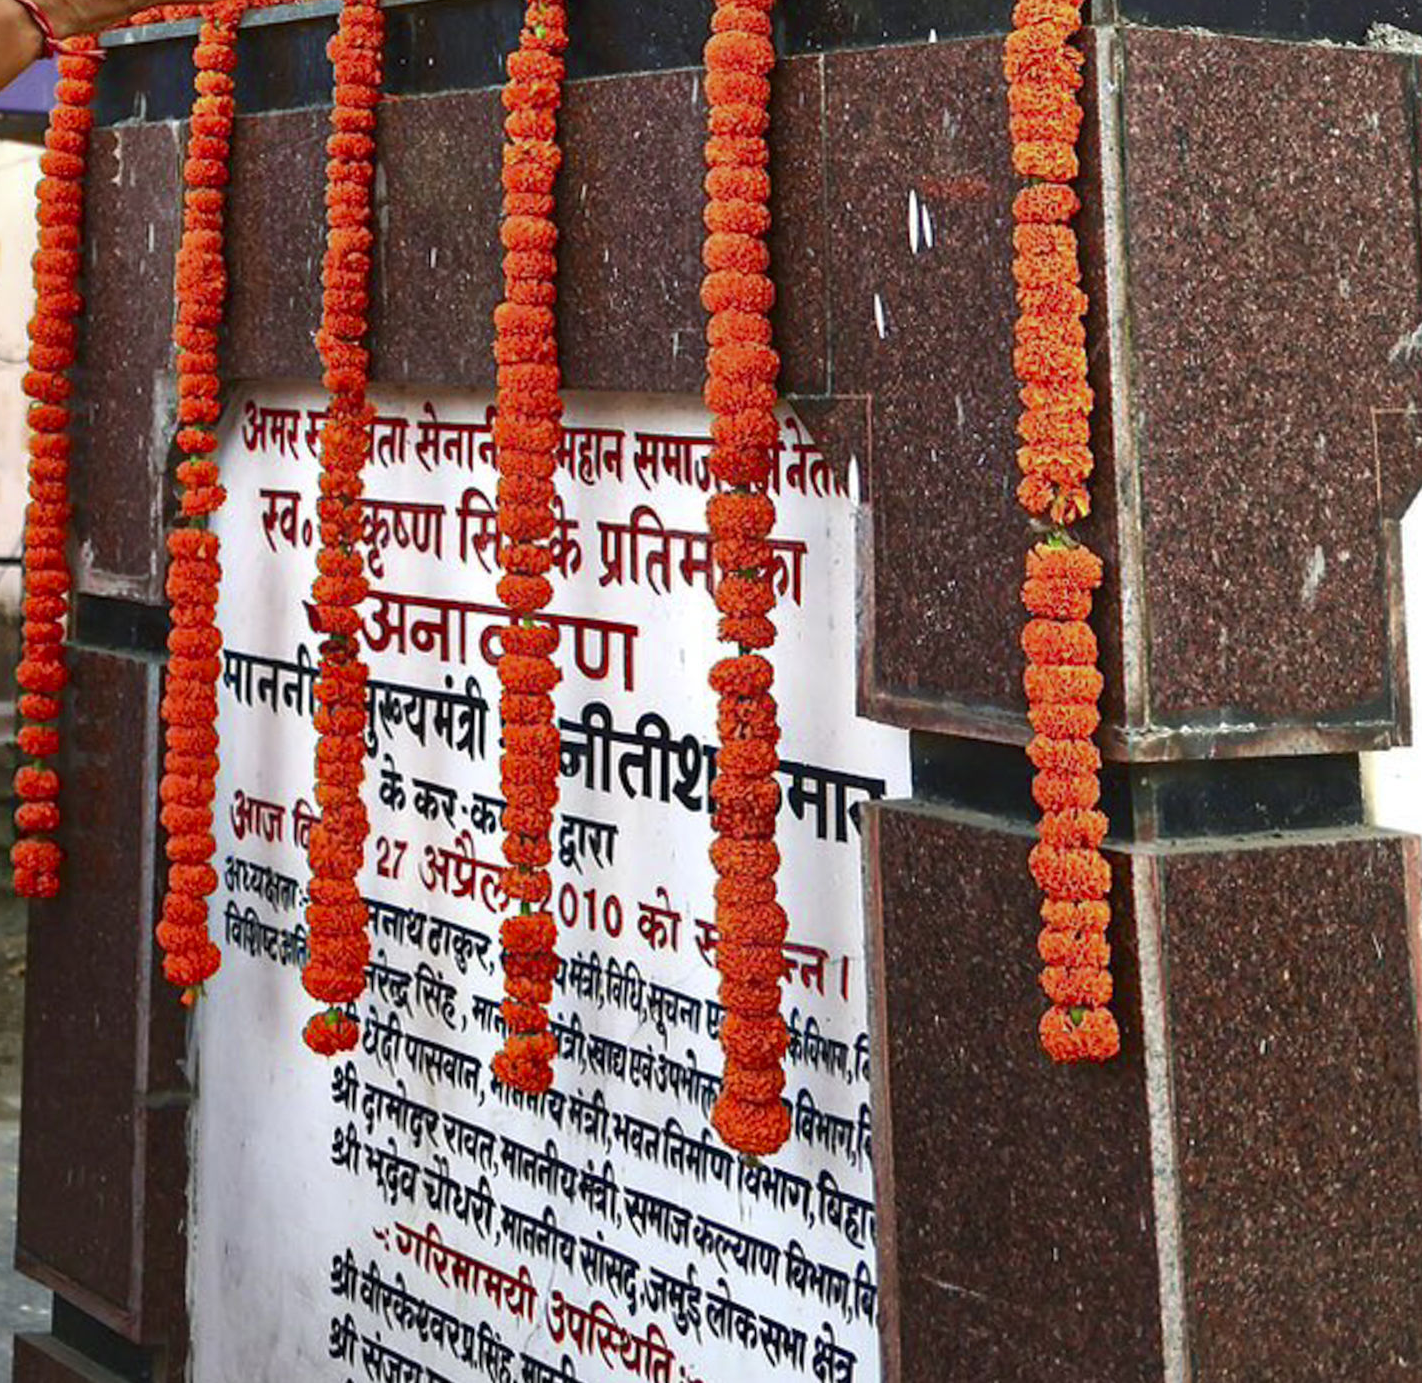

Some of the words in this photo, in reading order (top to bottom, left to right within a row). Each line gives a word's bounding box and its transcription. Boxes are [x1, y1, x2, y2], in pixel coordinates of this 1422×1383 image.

[242, 399, 301, 460] अमर
[550, 495, 582, 580] के
[379, 753, 407, 812] के
[558, 812, 618, 875] द्वारा
[230, 789, 285, 843] आज
[375, 836, 408, 880] 27
[636, 887, 682, 953] को
[331, 1060, 360, 1113] श्री
[499, 1137, 578, 1204] माननीय
[623, 1185, 693, 1248] समाज
[331, 1121, 362, 1175] श्री
[499, 1204, 578, 1277] माननीय
[331, 1247, 359, 1303] श्री
[394, 1220, 538, 1323] गरिमामयी
[329, 1313, 359, 1367] श्री
